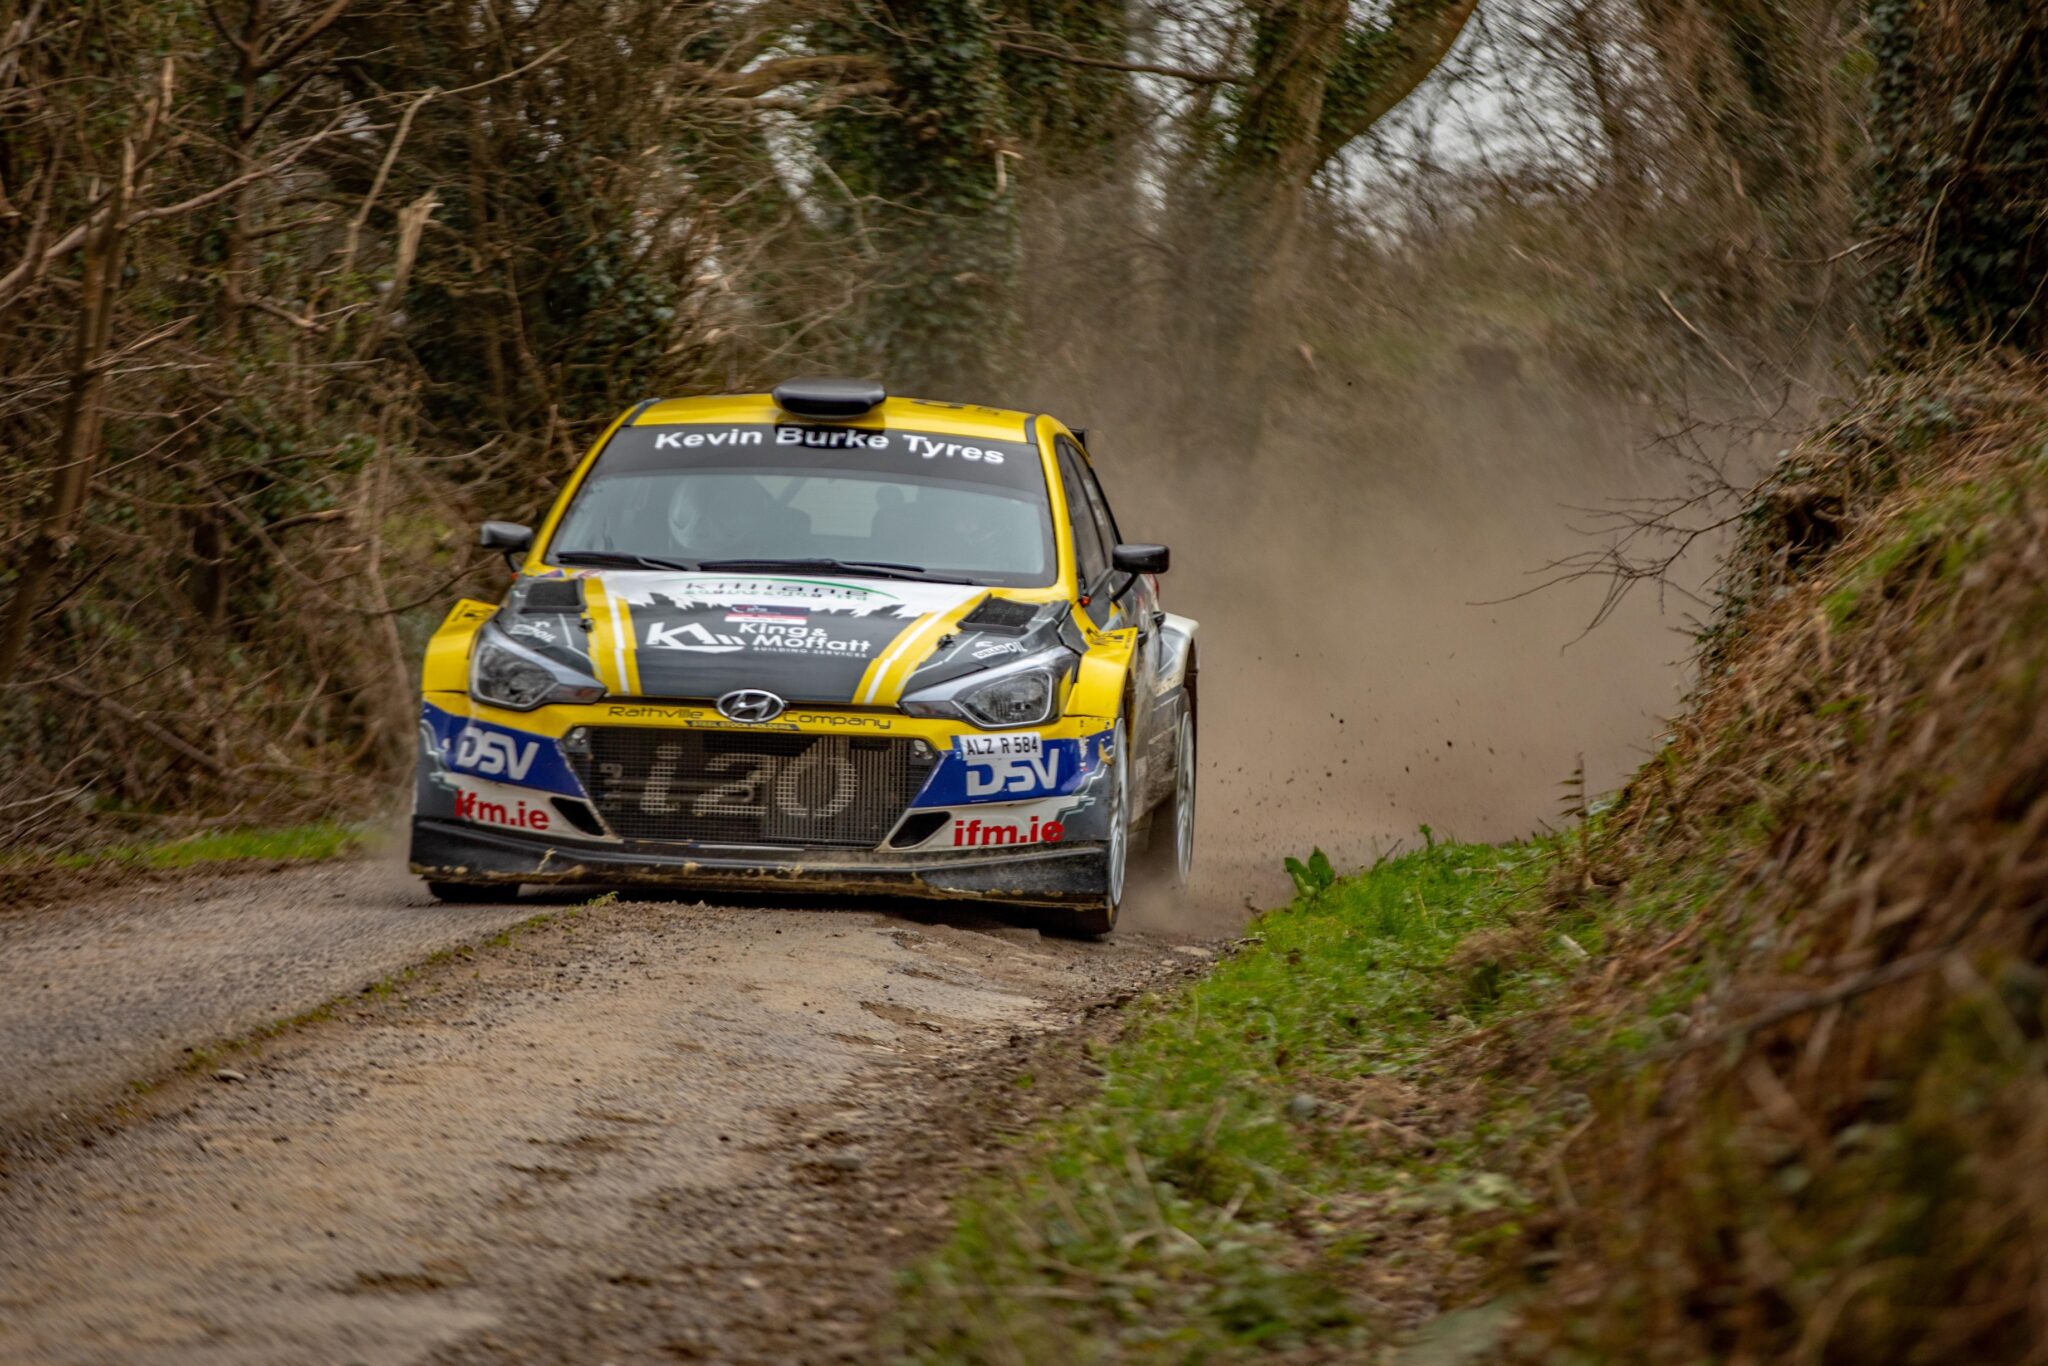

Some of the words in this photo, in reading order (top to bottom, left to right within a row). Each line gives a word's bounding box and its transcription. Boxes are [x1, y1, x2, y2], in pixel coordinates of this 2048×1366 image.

[655, 428, 763, 449] Kevin
[775, 427, 890, 449] Burke
[903, 434, 1005, 464] Tyres
[738, 622, 810, 638] King
[752, 635, 872, 653] Moffatt
[753, 646, 808, 654] BUILDING
[812, 648, 867, 659] SERVICES
[607, 706, 705, 719] Rathville
[783, 711, 891, 730] Company
[456, 726, 540, 781] DSV
[966, 738, 995, 756] ALZ
[1000, 737, 1011, 754] R
[1013, 736, 1038, 753] 584
[966, 748, 1060, 796] DSV
[454, 789, 550, 830] ifm.ie
[953, 815, 1065, 847] ifm.ie
